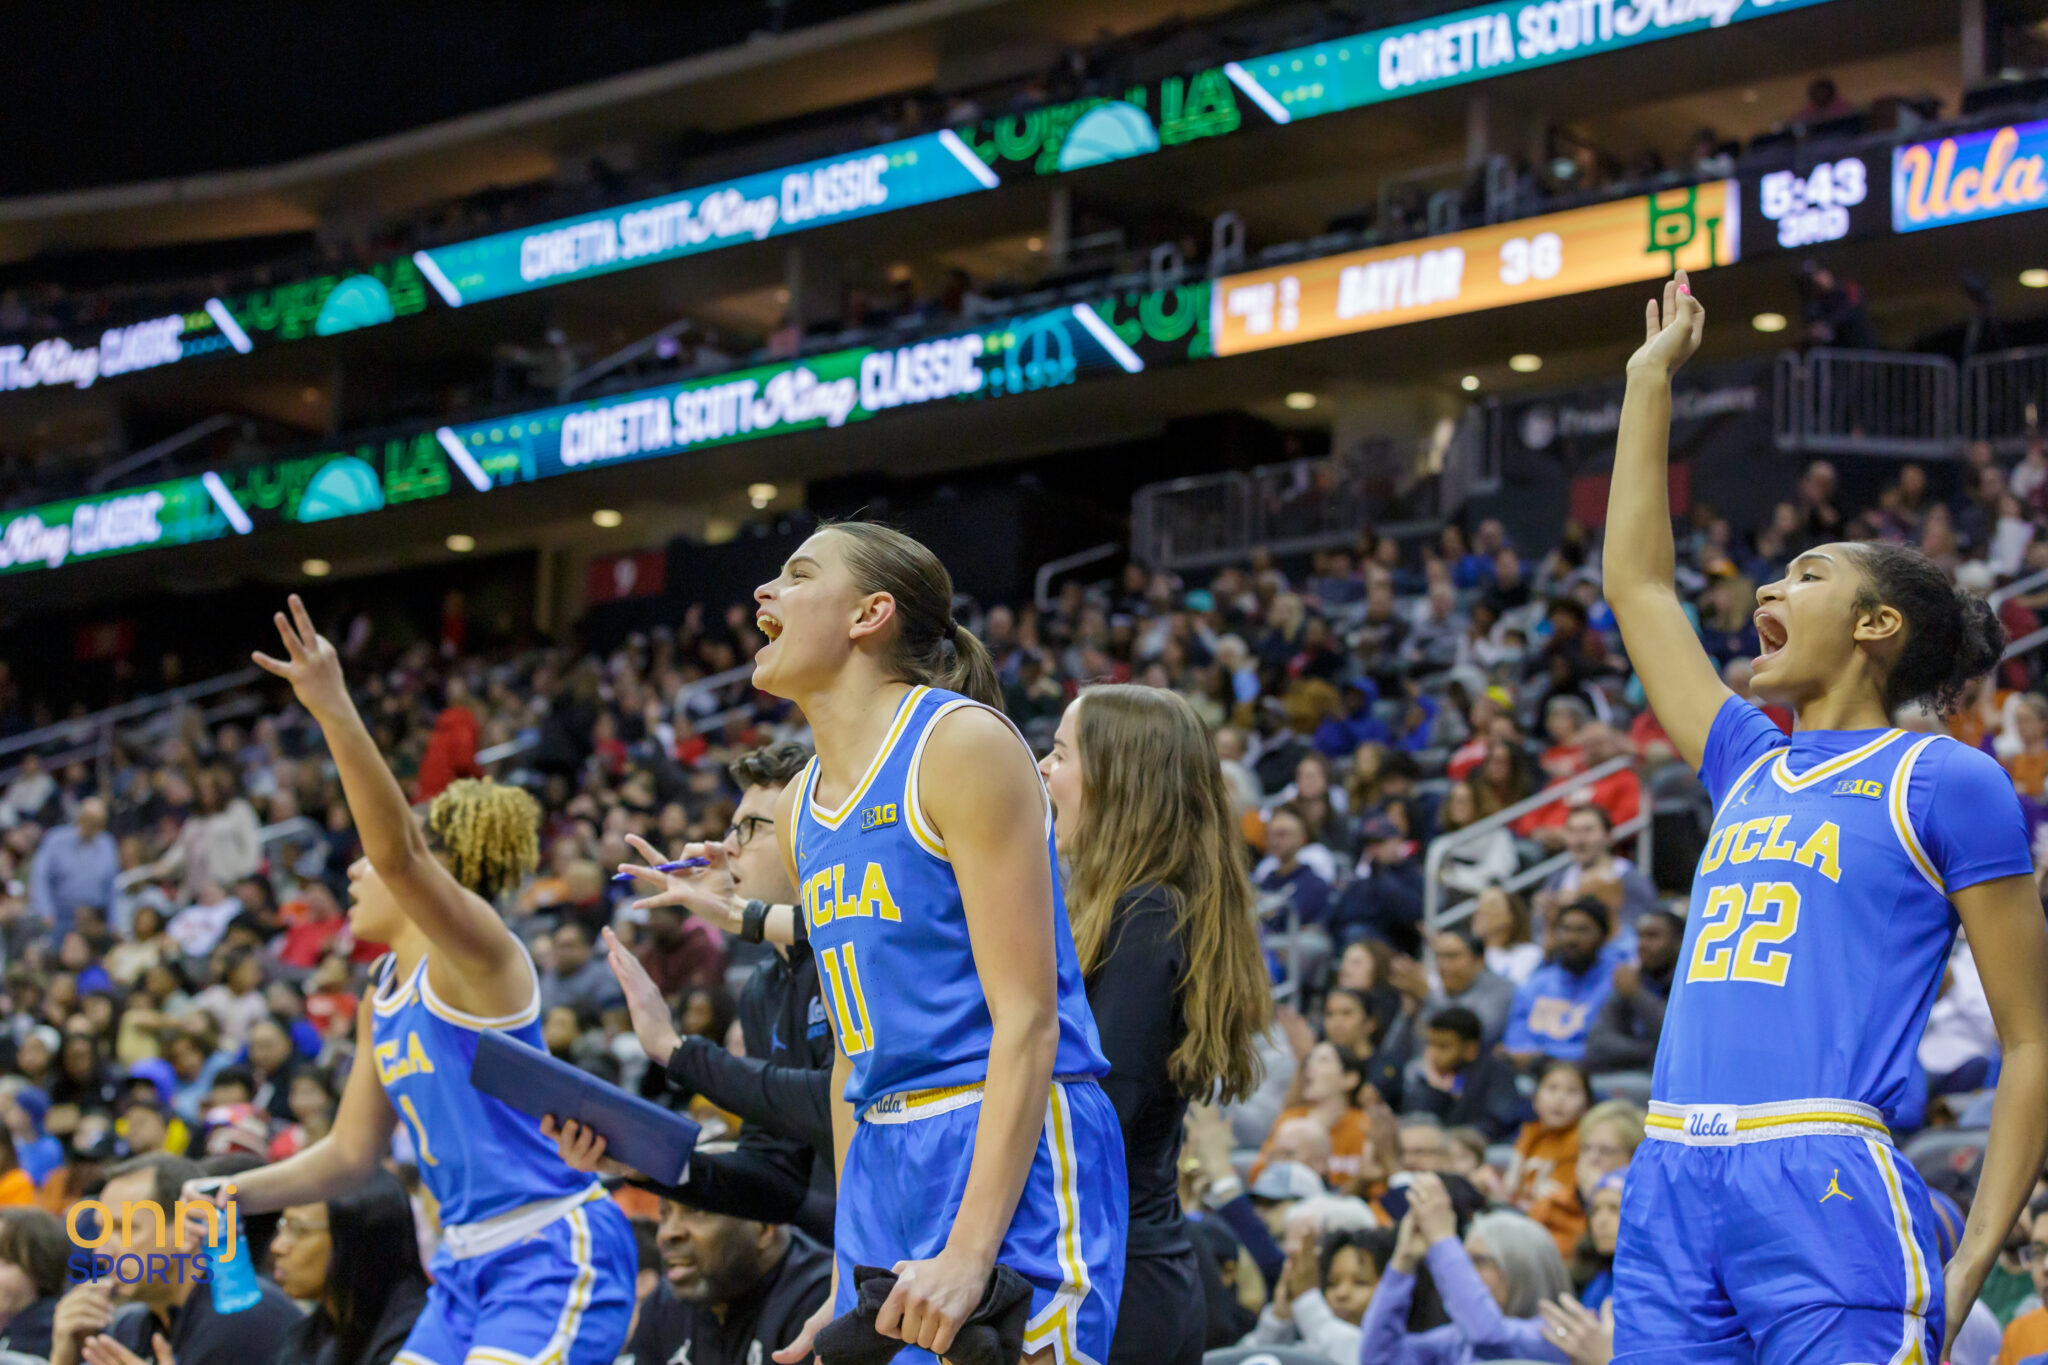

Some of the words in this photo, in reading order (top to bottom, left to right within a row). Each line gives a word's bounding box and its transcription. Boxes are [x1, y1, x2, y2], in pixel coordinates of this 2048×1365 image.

[1379, 12, 1515, 90] CORETTA
[520, 219, 618, 282] CORETTA
[619, 200, 692, 260] SCOTT
[685, 188, 779, 240] King
[781, 154, 889, 224] CLASSIC
[1761, 157, 1867, 220] 5:43
[1337, 246, 1465, 319] BAYLOR
[100, 304, 184, 377] CLASSIC
[560, 398, 672, 466] CORETTA
[674, 378, 758, 445] SCOTT
[752, 366, 859, 428] King
[860, 333, 984, 411] CLASSIC
[71, 491, 163, 555] CLASSIC
[1700, 815, 1842, 883] UCLA
[1686, 881, 1801, 987] 22
[821, 941, 875, 1056] 11
[1690, 1112, 1729, 1136] Ucla
